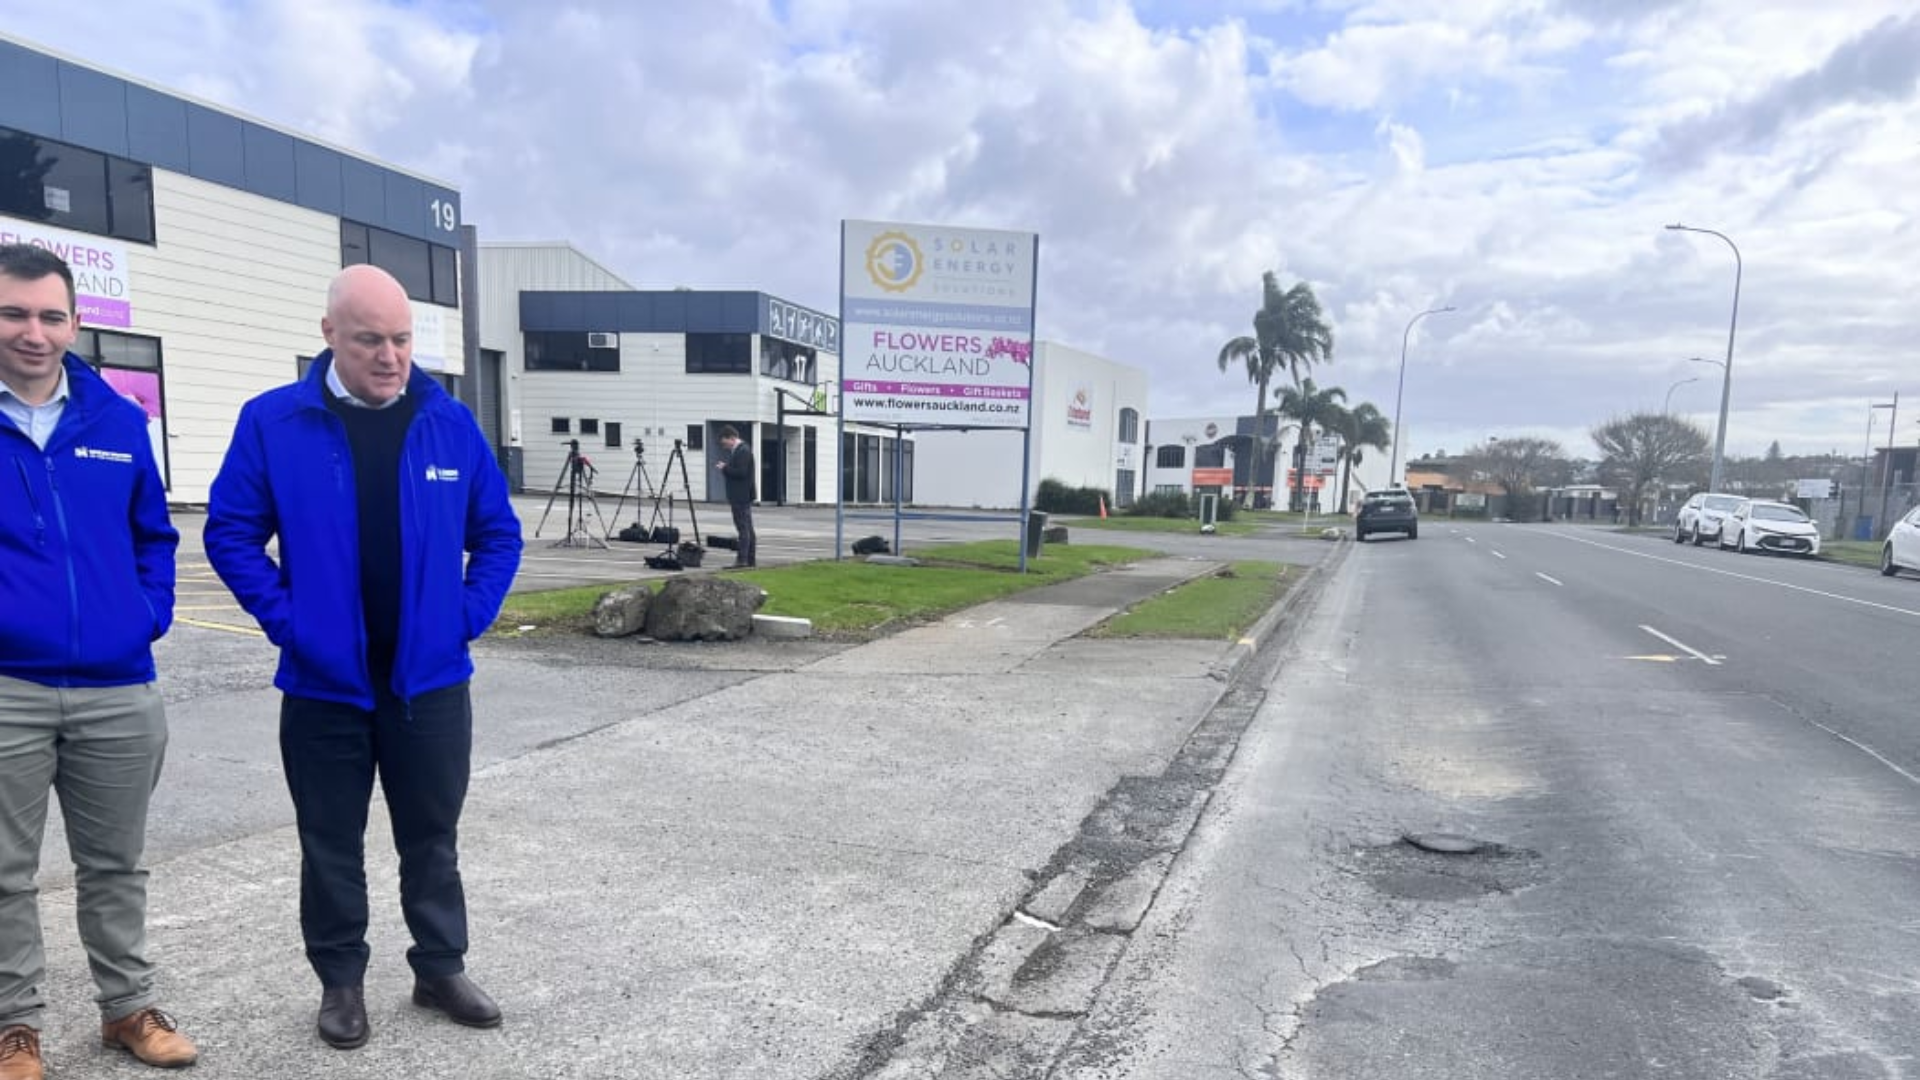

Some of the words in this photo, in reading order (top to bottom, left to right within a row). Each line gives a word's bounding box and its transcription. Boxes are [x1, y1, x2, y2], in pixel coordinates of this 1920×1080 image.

[431, 199, 454, 231] 19
[933, 237, 1016, 256] SOLAR
[933, 257, 1015, 275] ENERGY
[873, 330, 983, 354] FLOWERS
[794, 353, 808, 384] 17
[866, 353, 990, 377] AUCKLAND
[852, 382, 878, 393] Gifts
[900, 383, 941, 395] Flowers
[962, 387, 979, 397] Gift
[981, 387, 1022, 398] Baskets
[853, 397, 1020, 414] www.flowersauckland.co.nz
